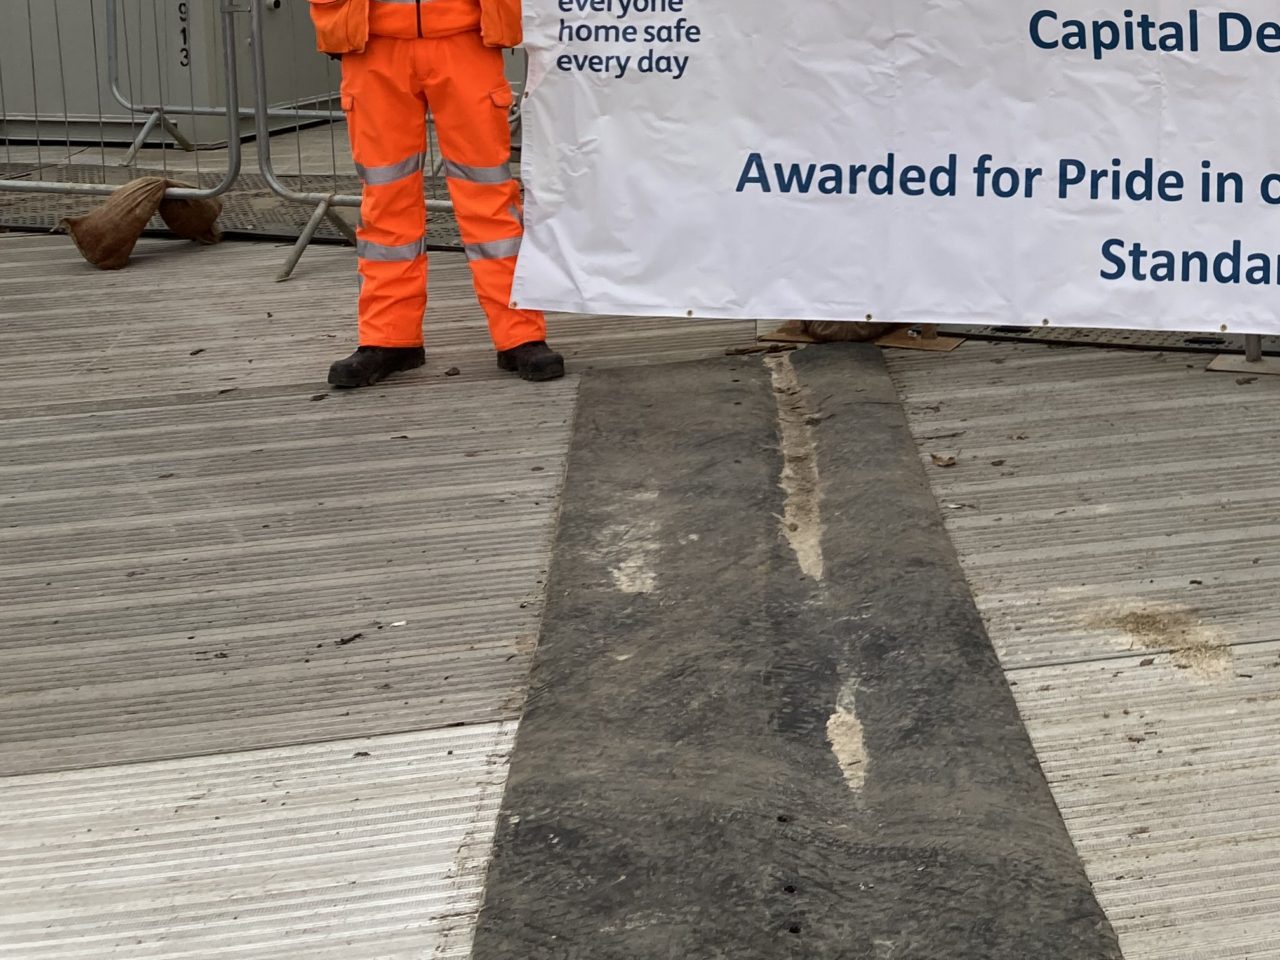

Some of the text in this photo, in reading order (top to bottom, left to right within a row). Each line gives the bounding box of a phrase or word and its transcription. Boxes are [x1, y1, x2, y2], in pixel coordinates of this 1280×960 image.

[558, 18, 701, 43] home safe
[1029, 9, 1199, 60] Capital
[556, 51, 689, 80] every day
[735, 152, 957, 197] Awarded
[972, 153, 1043, 198] for
[1058, 157, 1184, 202] Pride
[1201, 160, 1243, 204] in
